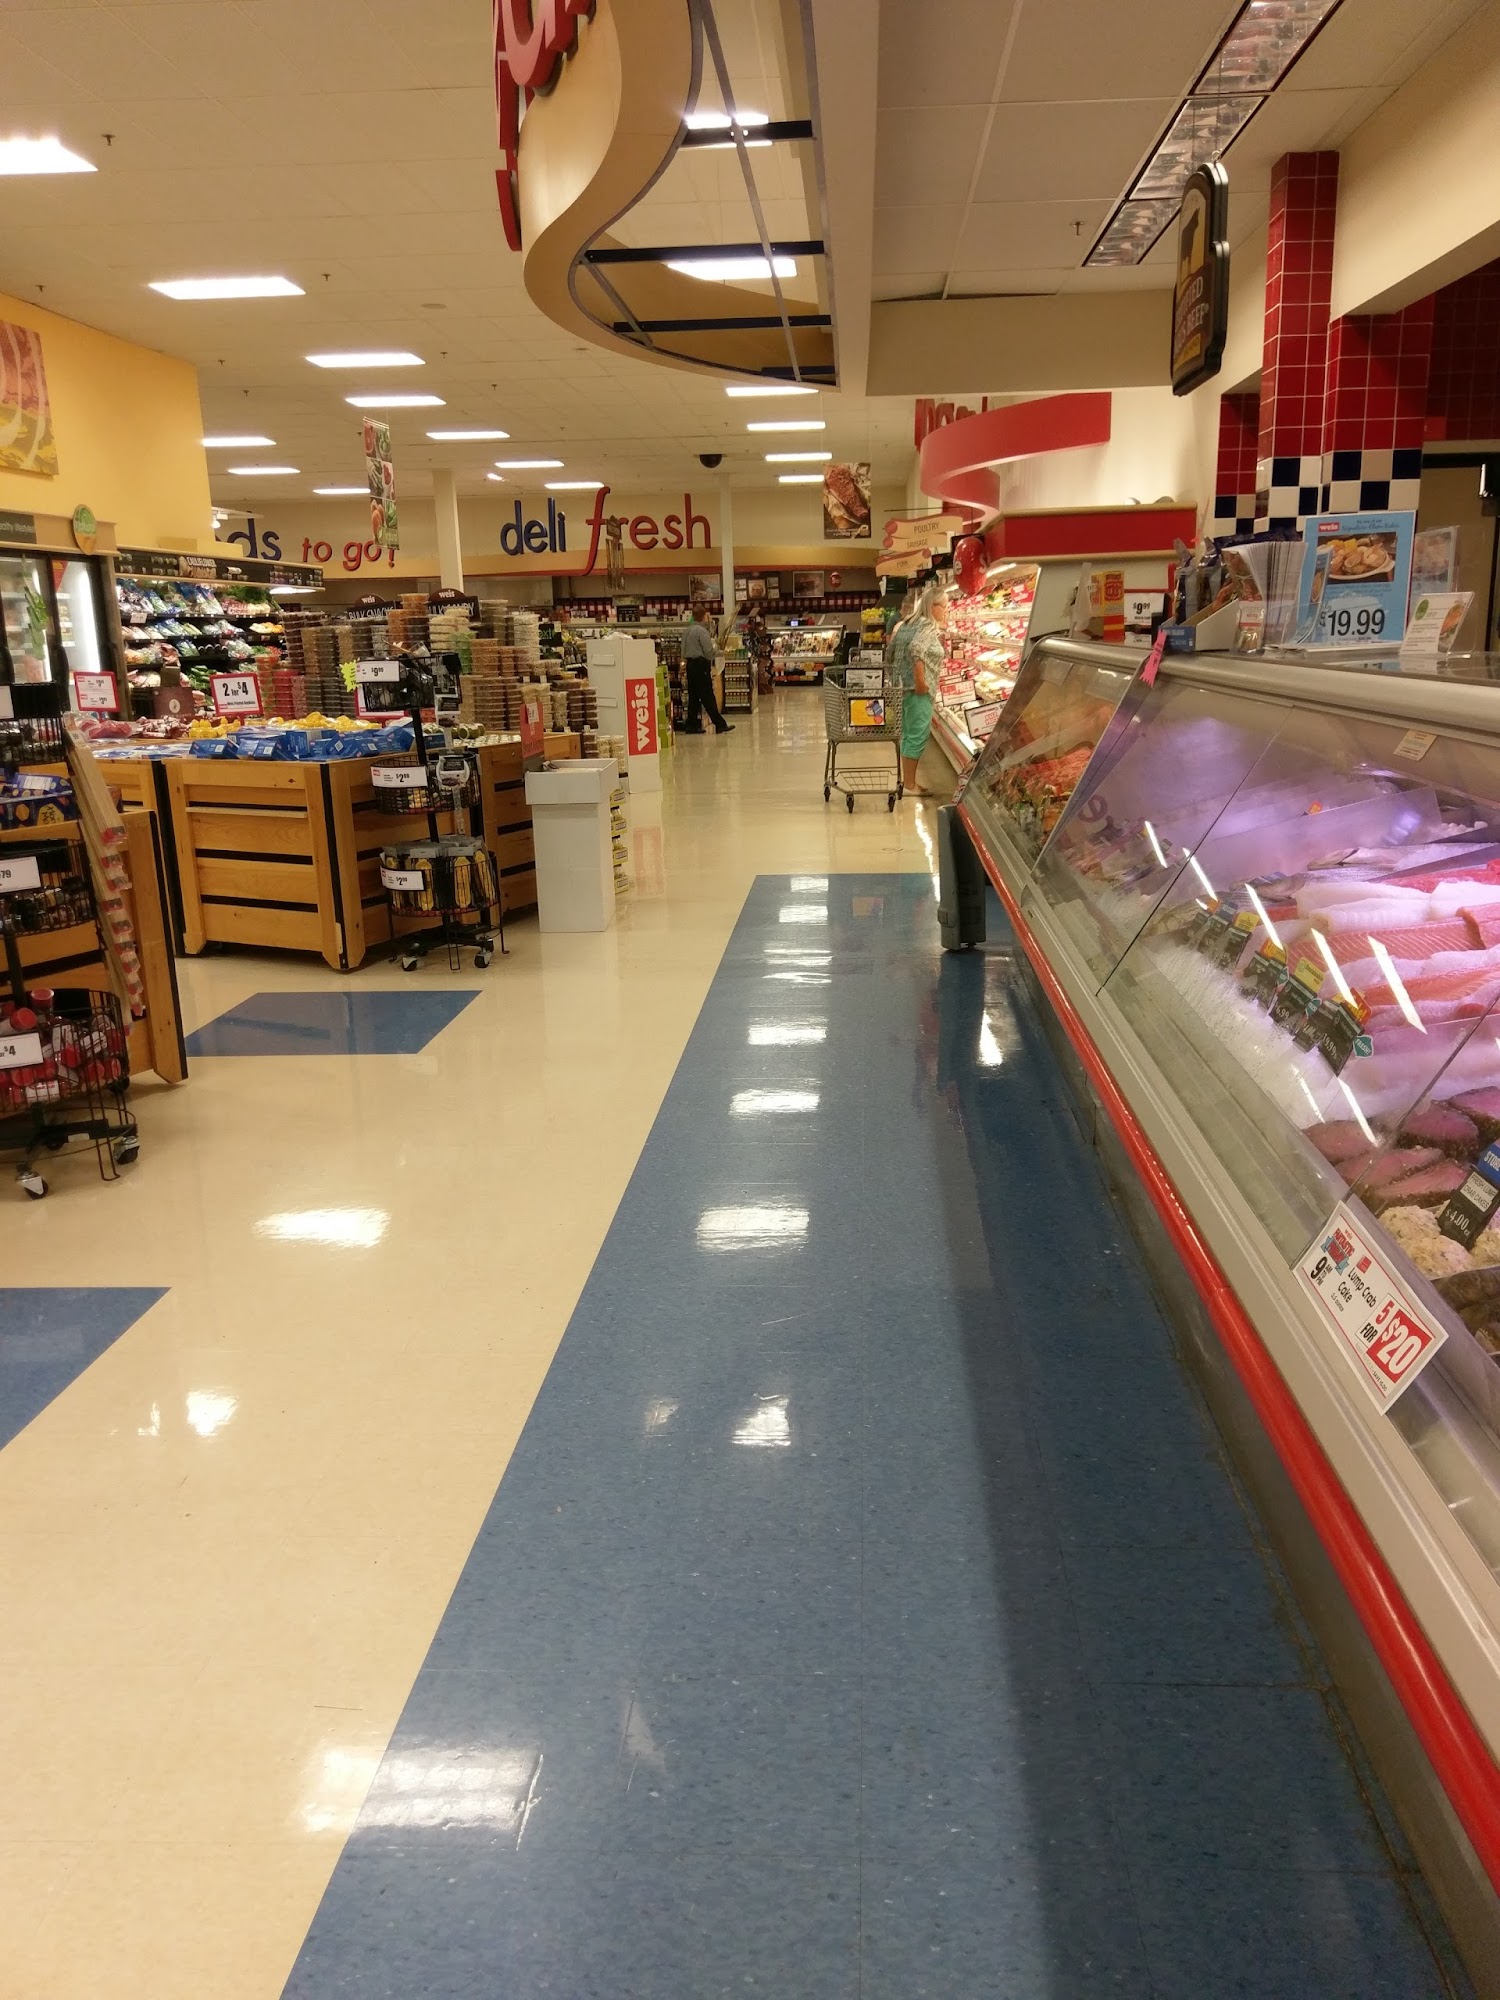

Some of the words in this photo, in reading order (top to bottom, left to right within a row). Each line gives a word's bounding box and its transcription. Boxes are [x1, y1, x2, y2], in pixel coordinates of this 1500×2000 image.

[216, 510, 282, 562] ds
[302, 537, 333, 562] to
[501, 497, 567, 556] deli
[914, 522, 940, 534] POULTRY
[906, 539, 929, 549] SAUSAGE
[362, 594, 376, 604] weis
[438, 589, 455, 599] weis
[222, 682, 230, 697] 2
[237, 681, 249, 696] $4
[631, 683, 651, 752] weis
[4, 1045, 16, 1056] $4
[1354, 1038, 1372, 1055] FRESH!
[1474, 1195, 1490, 1209] CAKES
[1333, 1227, 1355, 1258] FANTASTIC
[1310, 1256, 1328, 1280] 9
[1338, 1281, 1352, 1303] Cake
[1347, 1268, 1362, 1291] Lump
[1361, 1286, 1377, 1308] Crab
[1375, 1299, 1395, 1325] 5
[1360, 1322, 1378, 1343] FOR
[1376, 1317, 1422, 1375] $20
